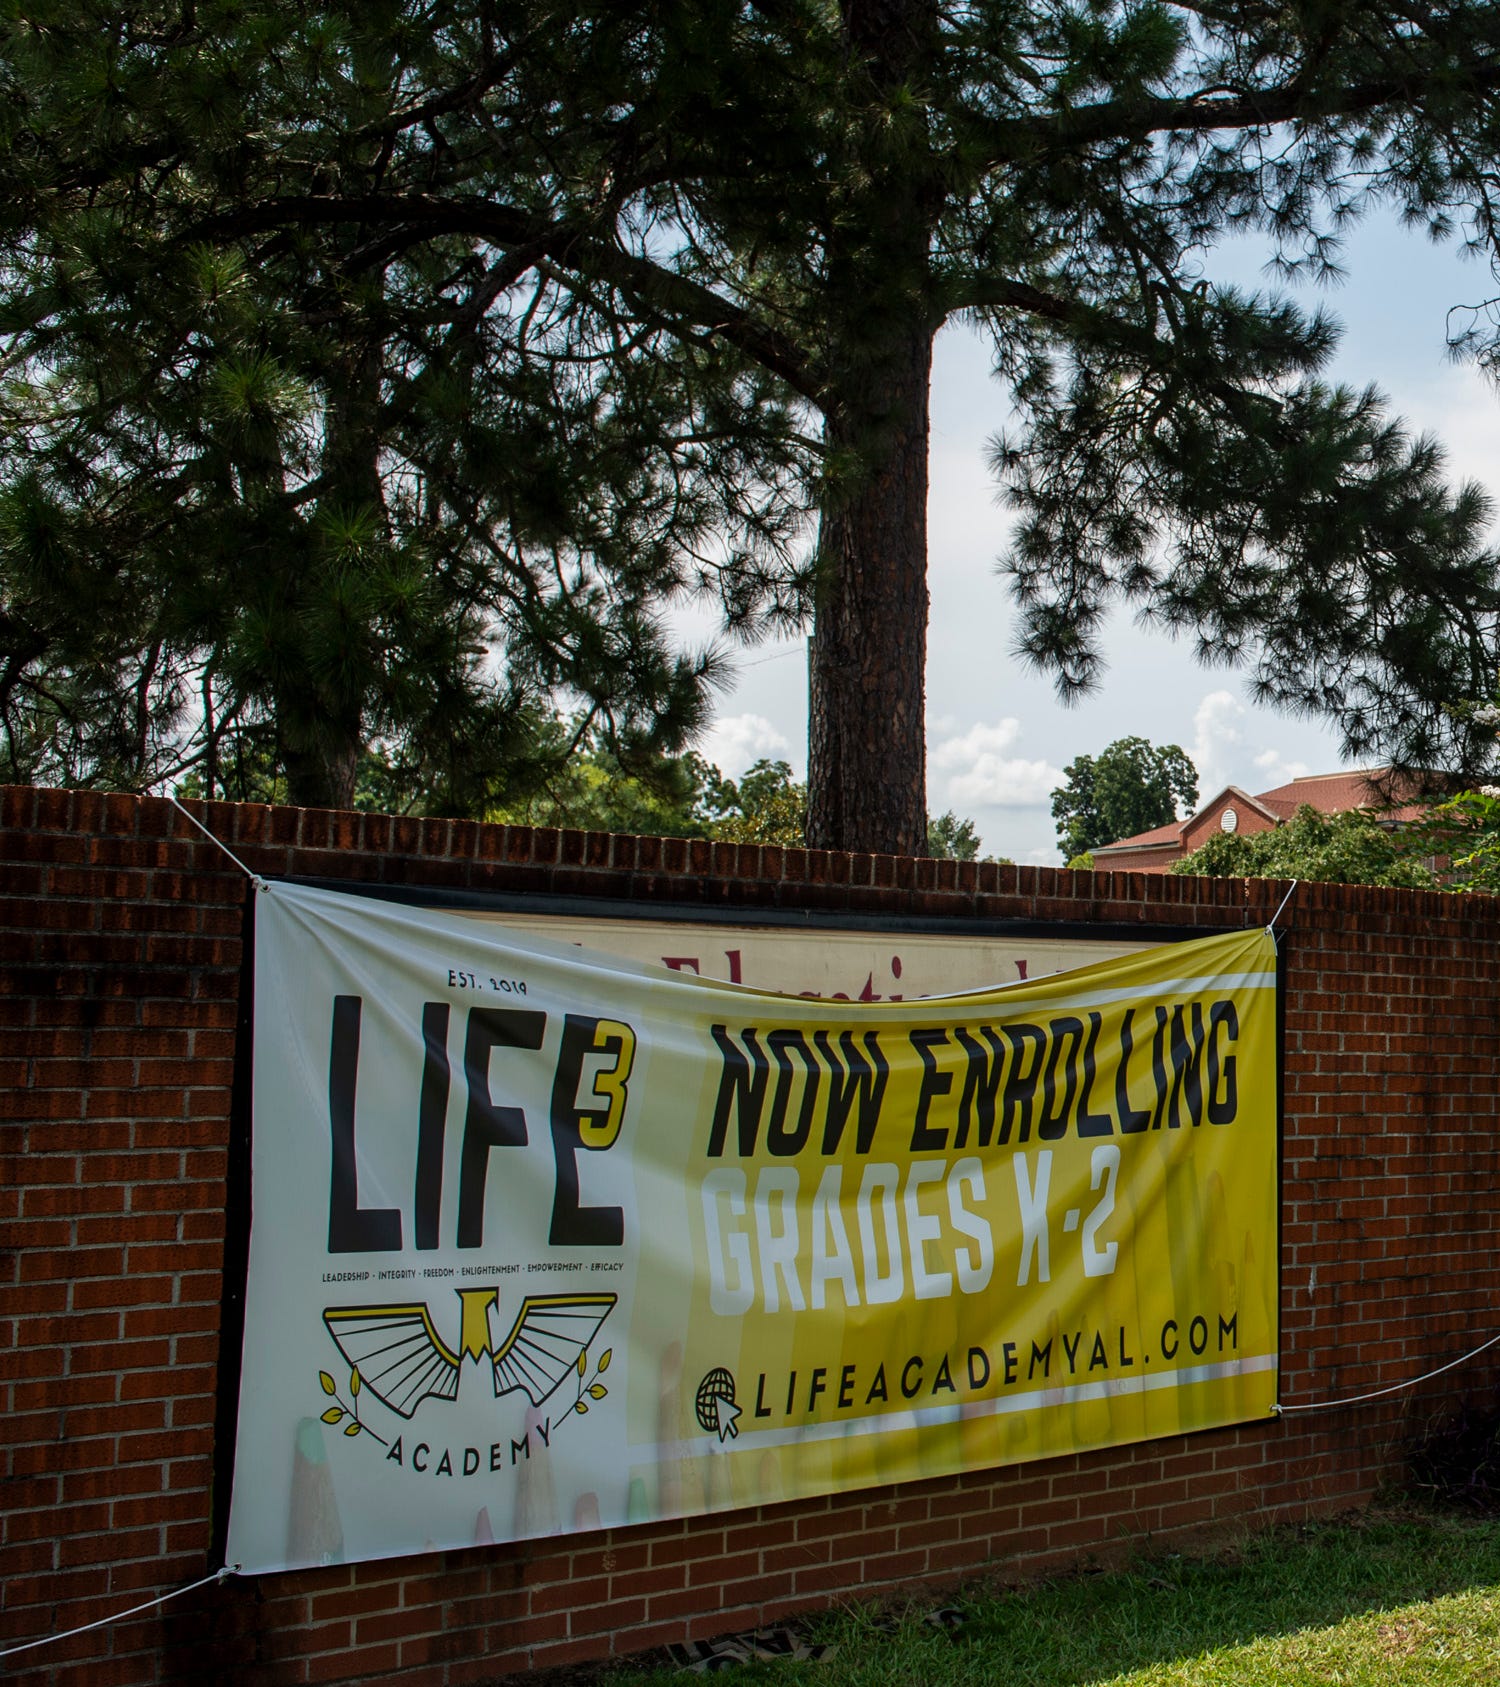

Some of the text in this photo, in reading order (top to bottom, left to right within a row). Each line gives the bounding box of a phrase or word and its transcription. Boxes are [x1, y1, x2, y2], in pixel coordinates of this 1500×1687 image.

[448, 969, 527, 995] EST. 2019
[707, 1000, 1239, 1157] NOW ENROLLING
[322, 1261, 625, 1283] LEADERSHIP INTEGRITY FREEDOM ENLIGHTENMENT EMPOWERMENT EFFICACY
[701, 1156, 995, 1316] GRADES
[754, 1311, 1239, 1418] LIFEACADEMYAL.COM
[386, 1416, 550, 1477] ACADEMY
